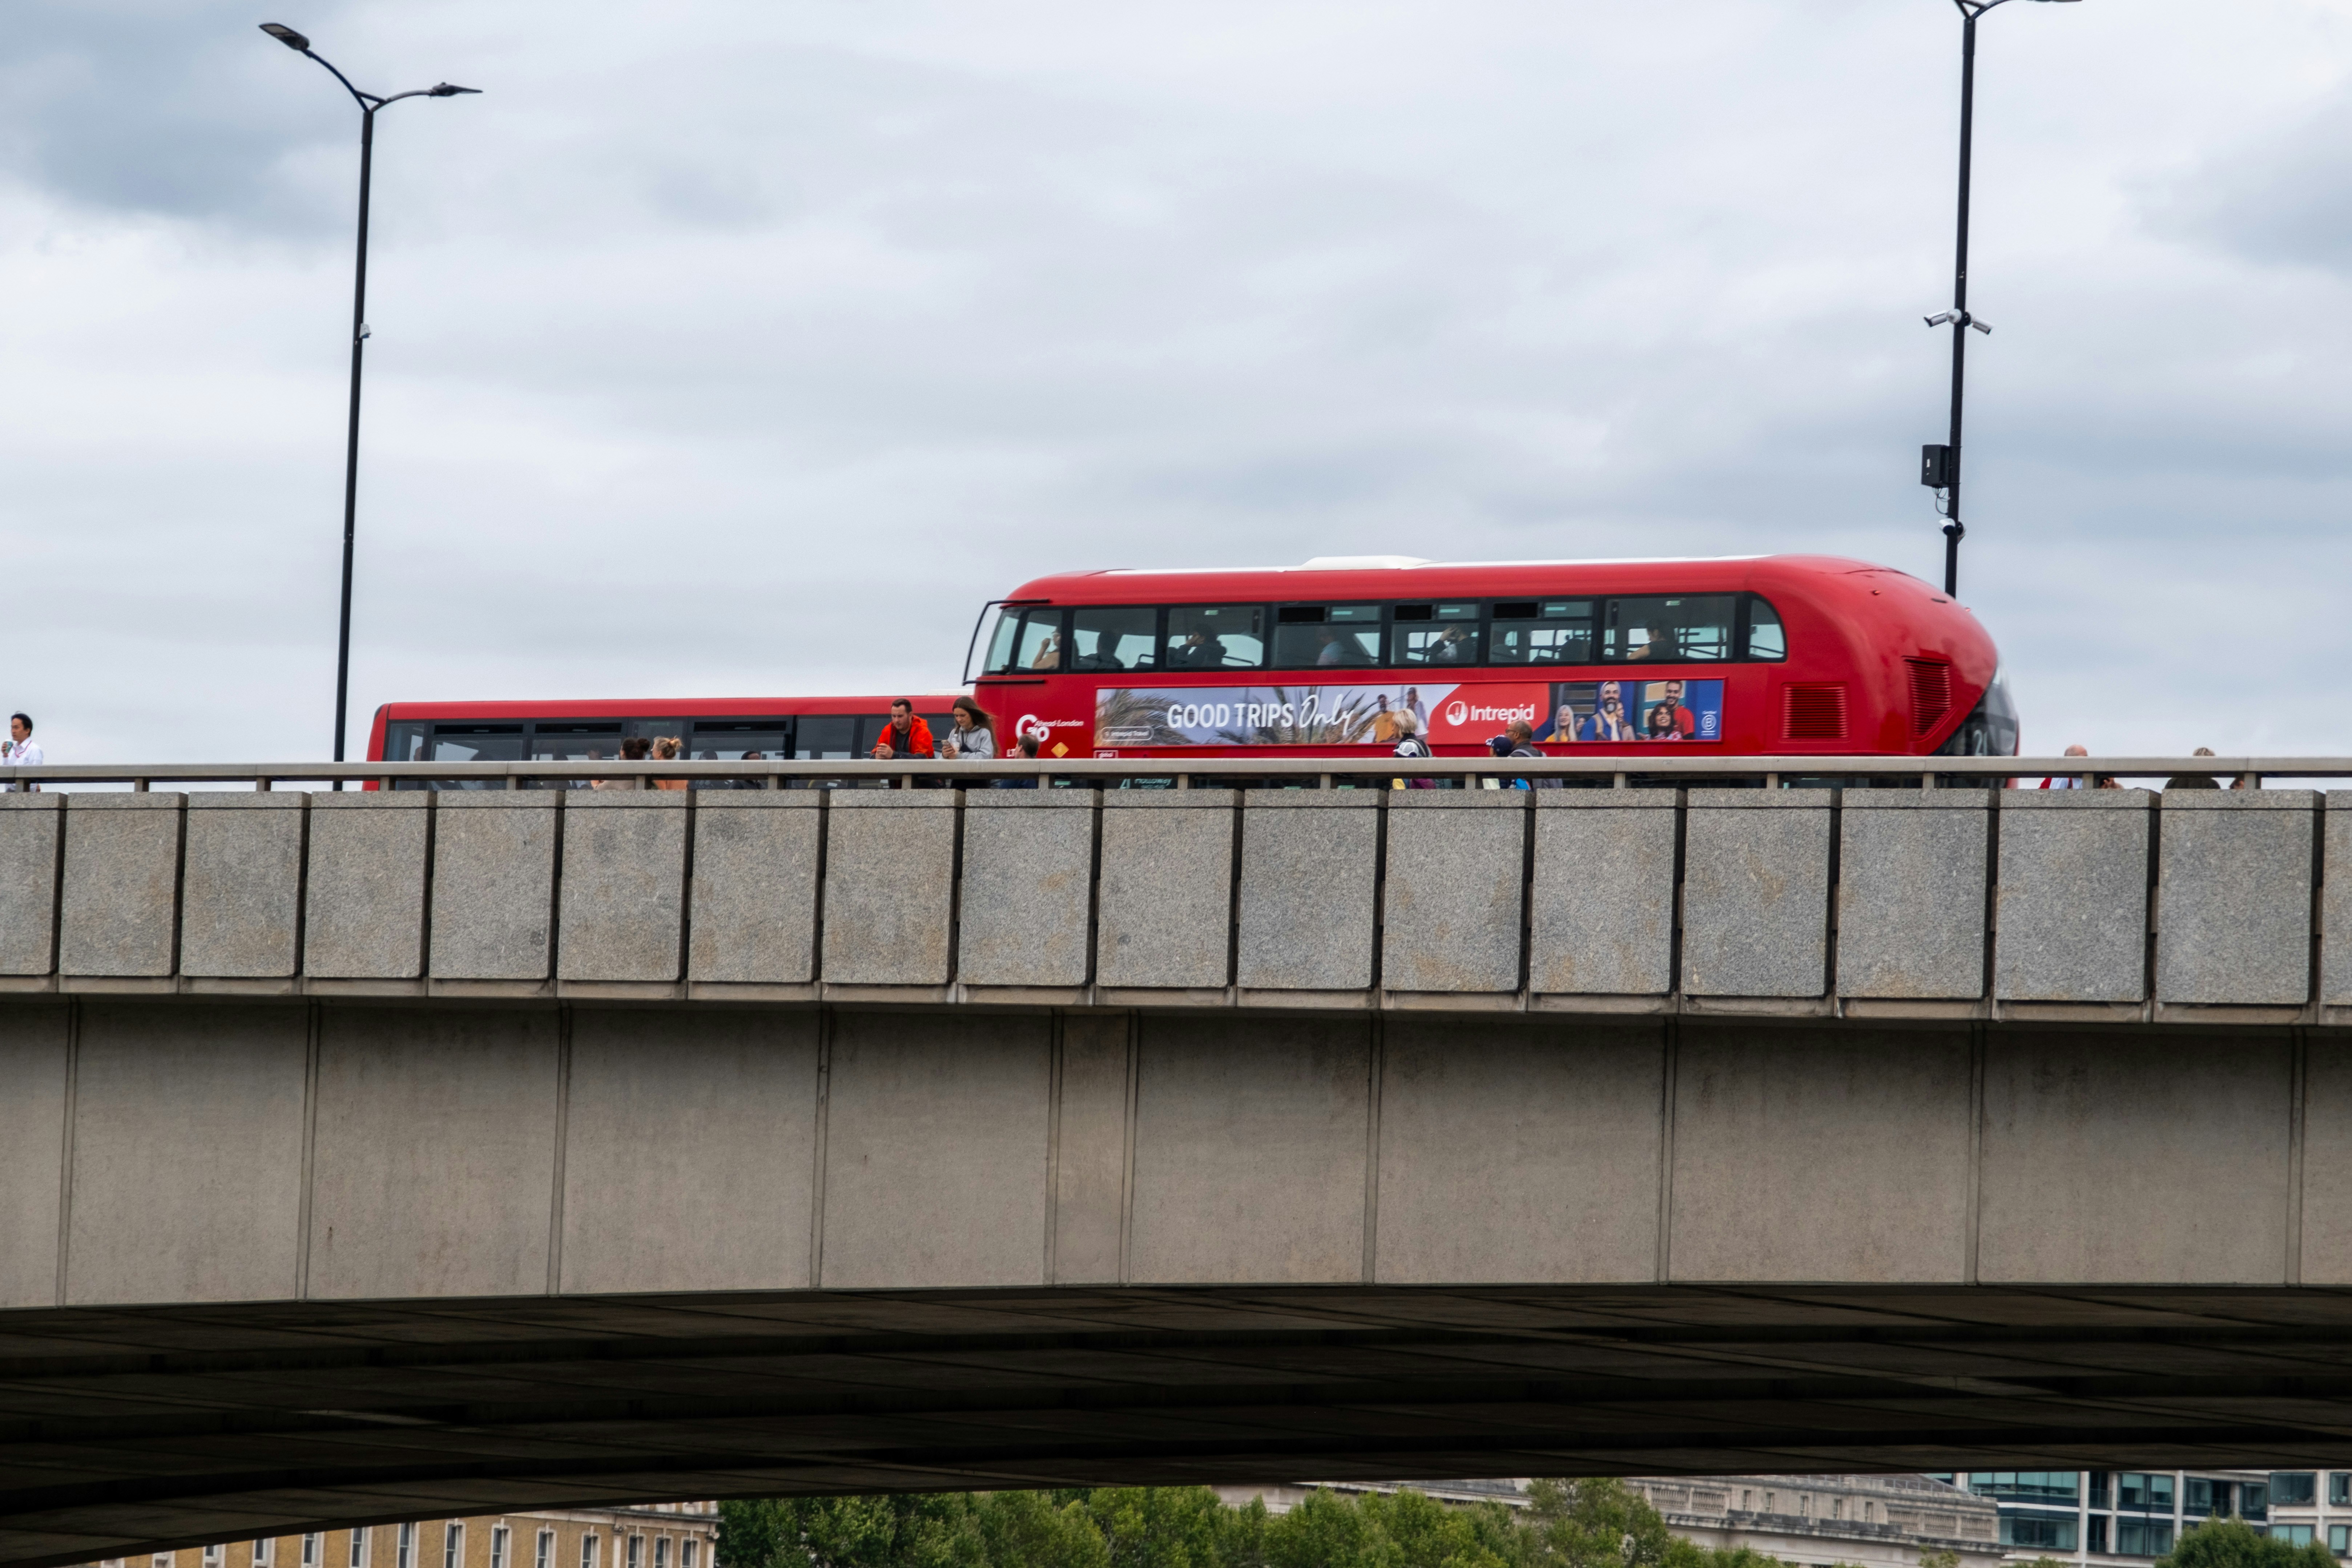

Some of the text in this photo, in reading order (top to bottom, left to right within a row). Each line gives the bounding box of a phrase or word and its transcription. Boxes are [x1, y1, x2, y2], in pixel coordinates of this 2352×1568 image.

[1167, 694, 1354, 735] GOOD TRIPS Only
[1471, 704, 1535, 724] Intrepid
[1973, 729, 1987, 756] 21
